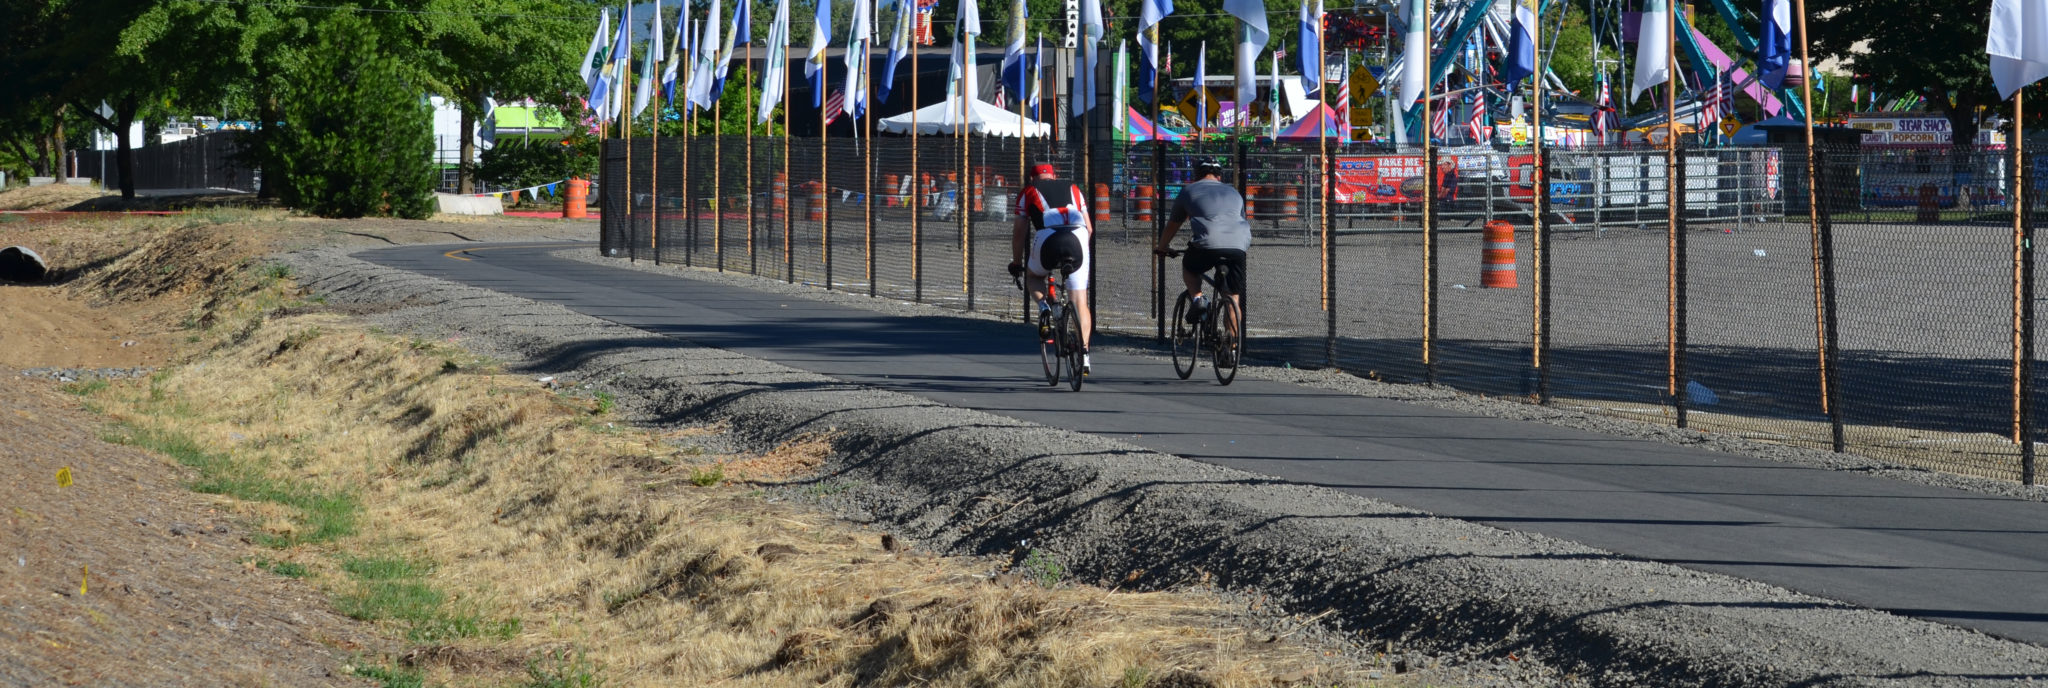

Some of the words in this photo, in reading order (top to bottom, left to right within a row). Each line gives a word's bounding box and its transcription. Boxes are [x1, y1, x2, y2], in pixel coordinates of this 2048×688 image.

[1899, 119, 1922, 131] SUGAR
[1923, 119, 1947, 131] SHACK
[1865, 134, 1882, 142] CANDY
[1893, 133, 1934, 142] POPCORN
[1378, 157, 1403, 167] TAKE
[1405, 157, 1420, 167] ME
